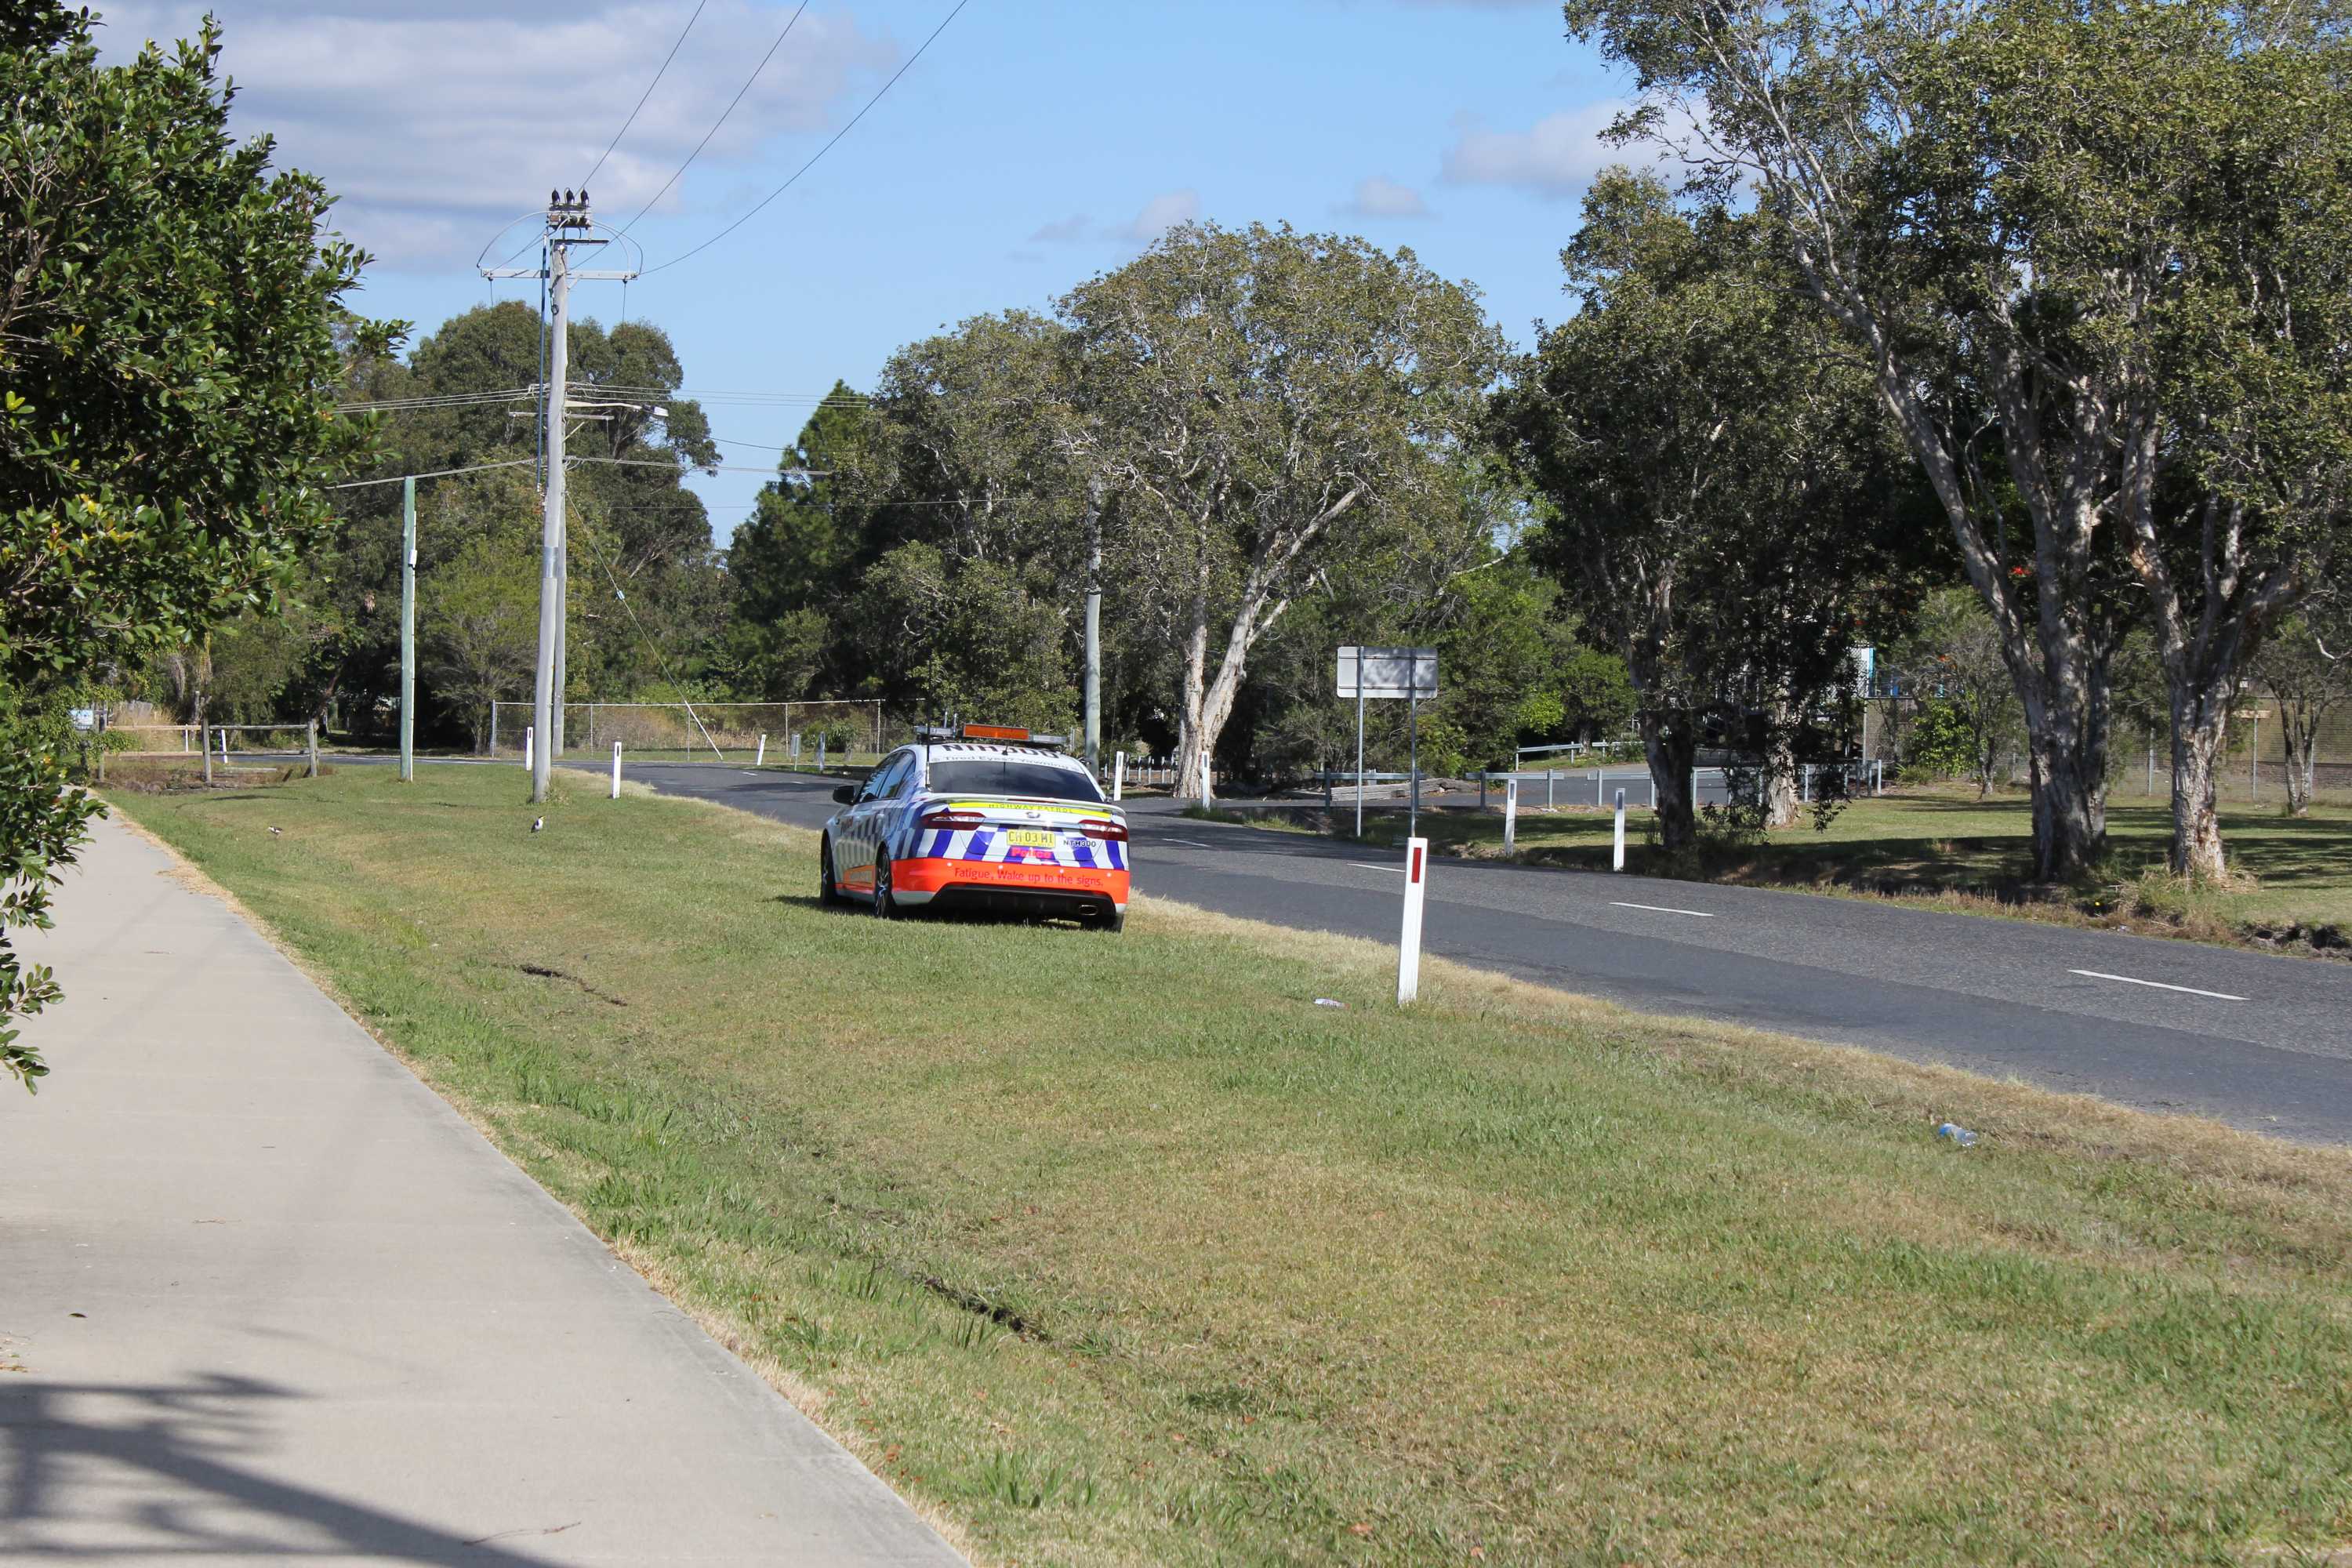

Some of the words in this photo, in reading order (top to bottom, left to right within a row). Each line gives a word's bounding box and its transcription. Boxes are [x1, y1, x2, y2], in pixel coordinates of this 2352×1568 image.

[1011, 847, 1051, 858] Police
[954, 867, 994, 880] Fatigue,
[997, 869, 1023, 880] Wake
[1028, 874, 1041, 884] up
[1044, 873, 1054, 883] to
[1058, 873, 1073, 884] the
[1076, 876, 1104, 887] signs.
